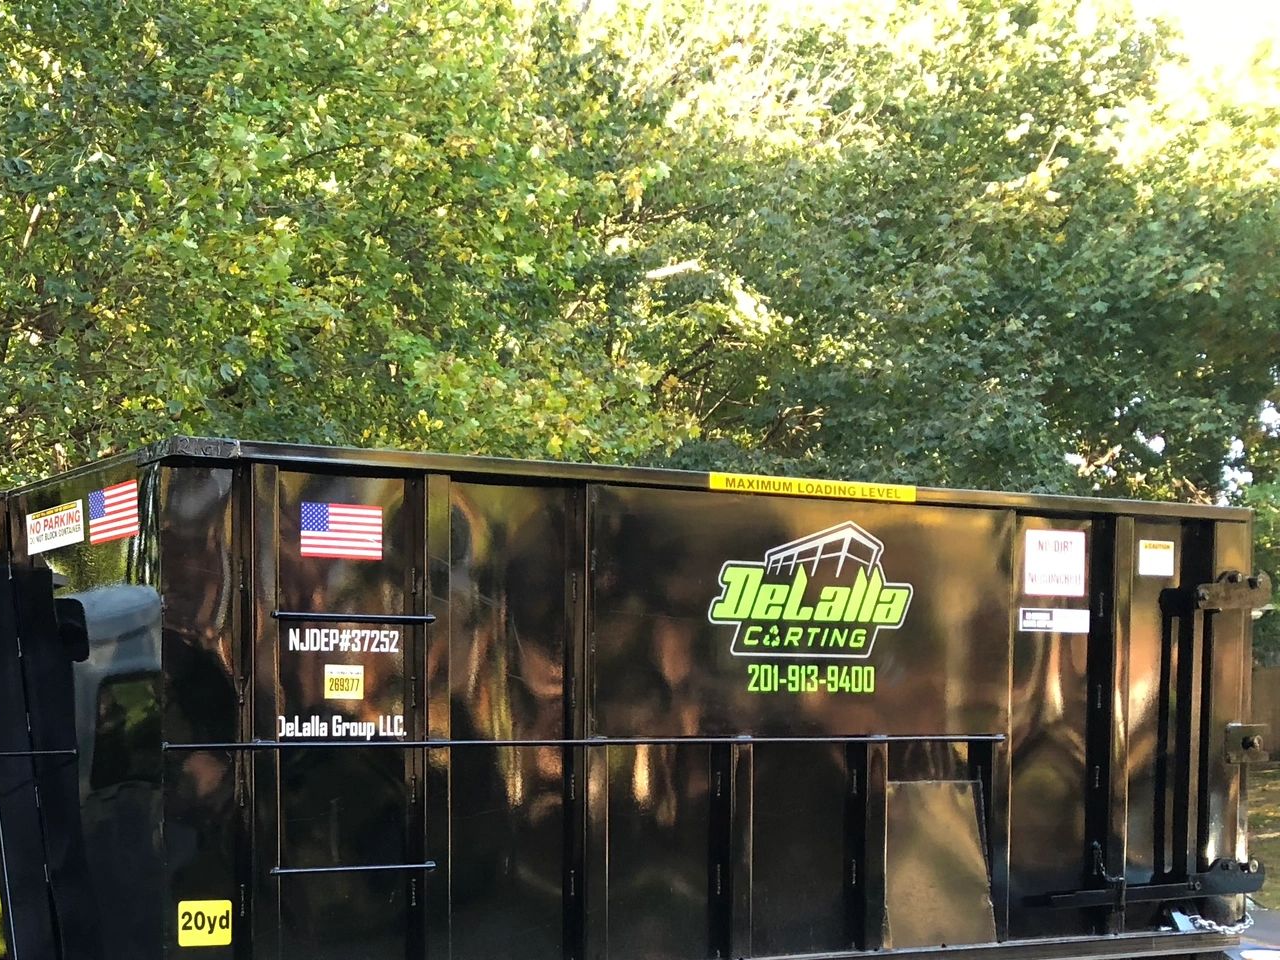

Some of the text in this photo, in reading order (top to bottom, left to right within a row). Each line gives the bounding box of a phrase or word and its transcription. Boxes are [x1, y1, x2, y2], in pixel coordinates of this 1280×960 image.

[725, 477, 901, 499] MAXIMUM LOADING LEVEL
[30, 520, 41, 535] NO
[43, 510, 80, 532] PARKING
[711, 564, 910, 623] DeLalla
[288, 628, 400, 653] NJDEP#37252
[329, 677, 360, 692] 269377
[747, 664, 875, 693] 201-913-9400
[278, 715, 407, 741] DeLalla Group LLC.
[182, 910, 230, 934] 20yd
